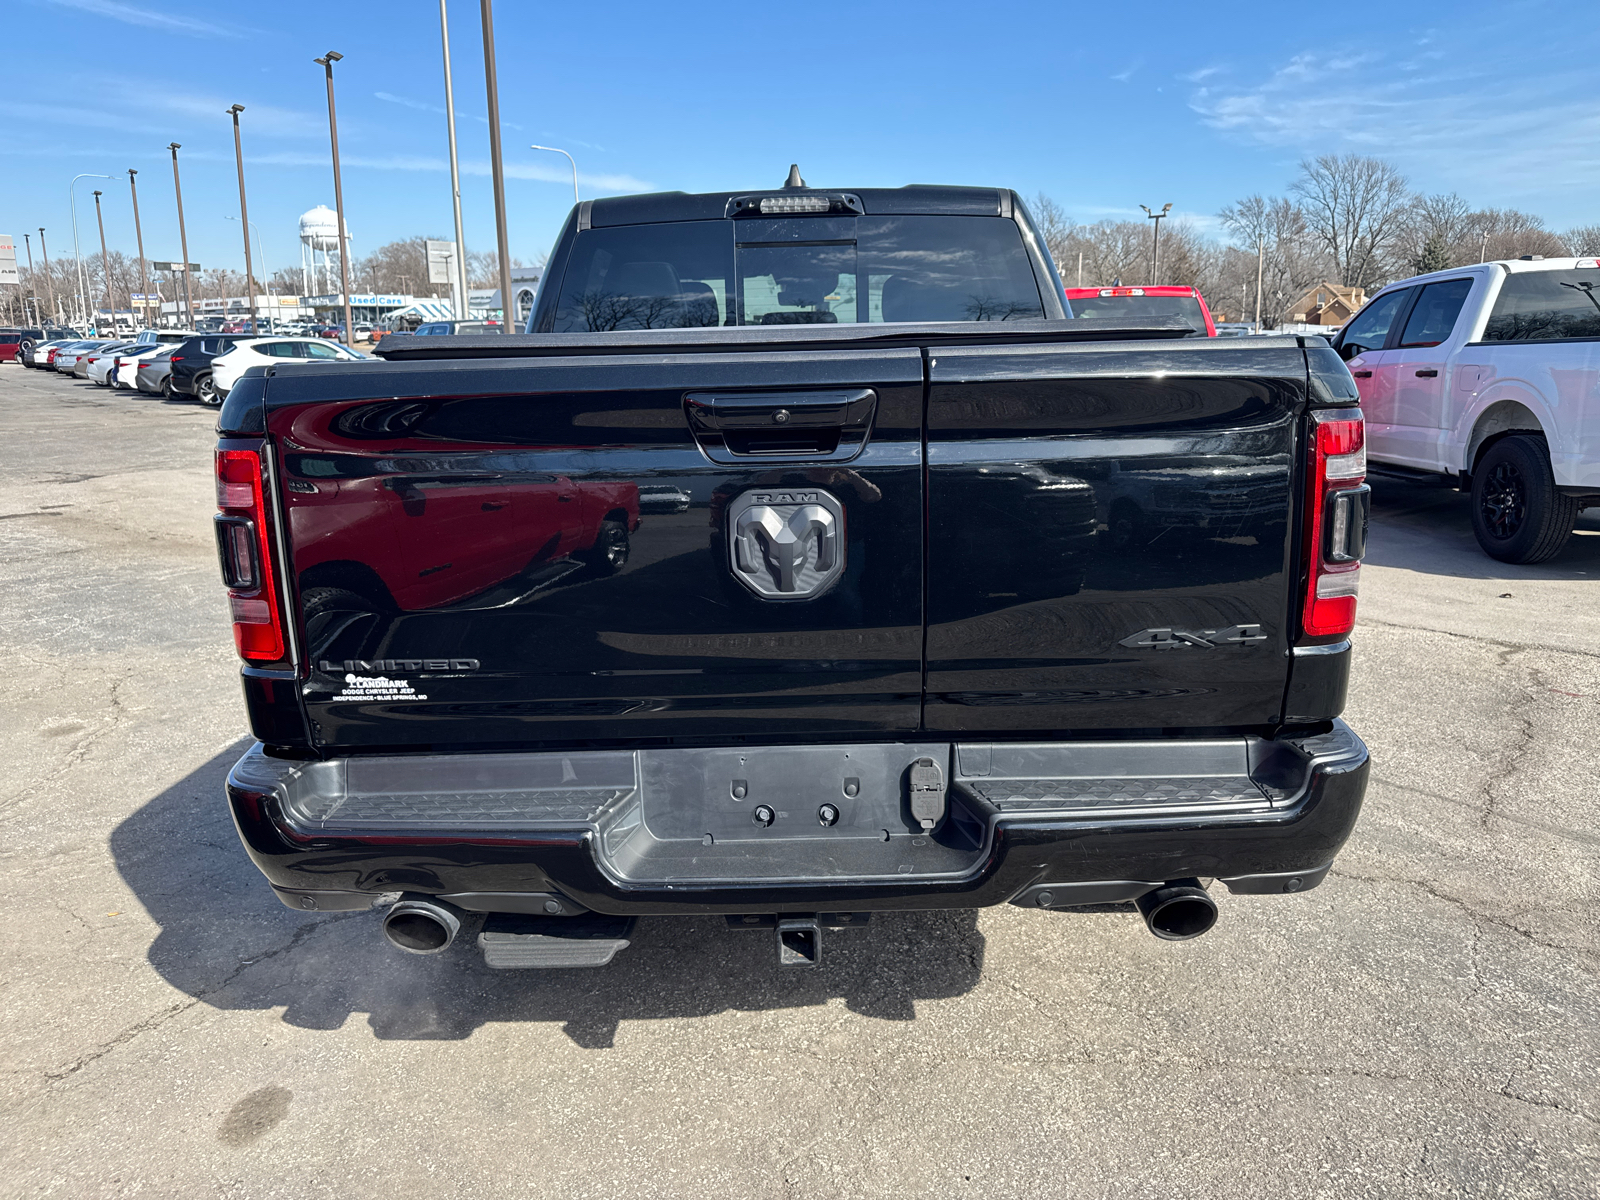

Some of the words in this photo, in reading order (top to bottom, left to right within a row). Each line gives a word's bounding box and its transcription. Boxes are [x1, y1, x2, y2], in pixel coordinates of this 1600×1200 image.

[349, 296, 376, 304] Used
[379, 297, 402, 305] Cars
[751, 493, 818, 502] RAM
[319, 659, 481, 672] LIMITED
[356, 680, 409, 688] LANDMARK
